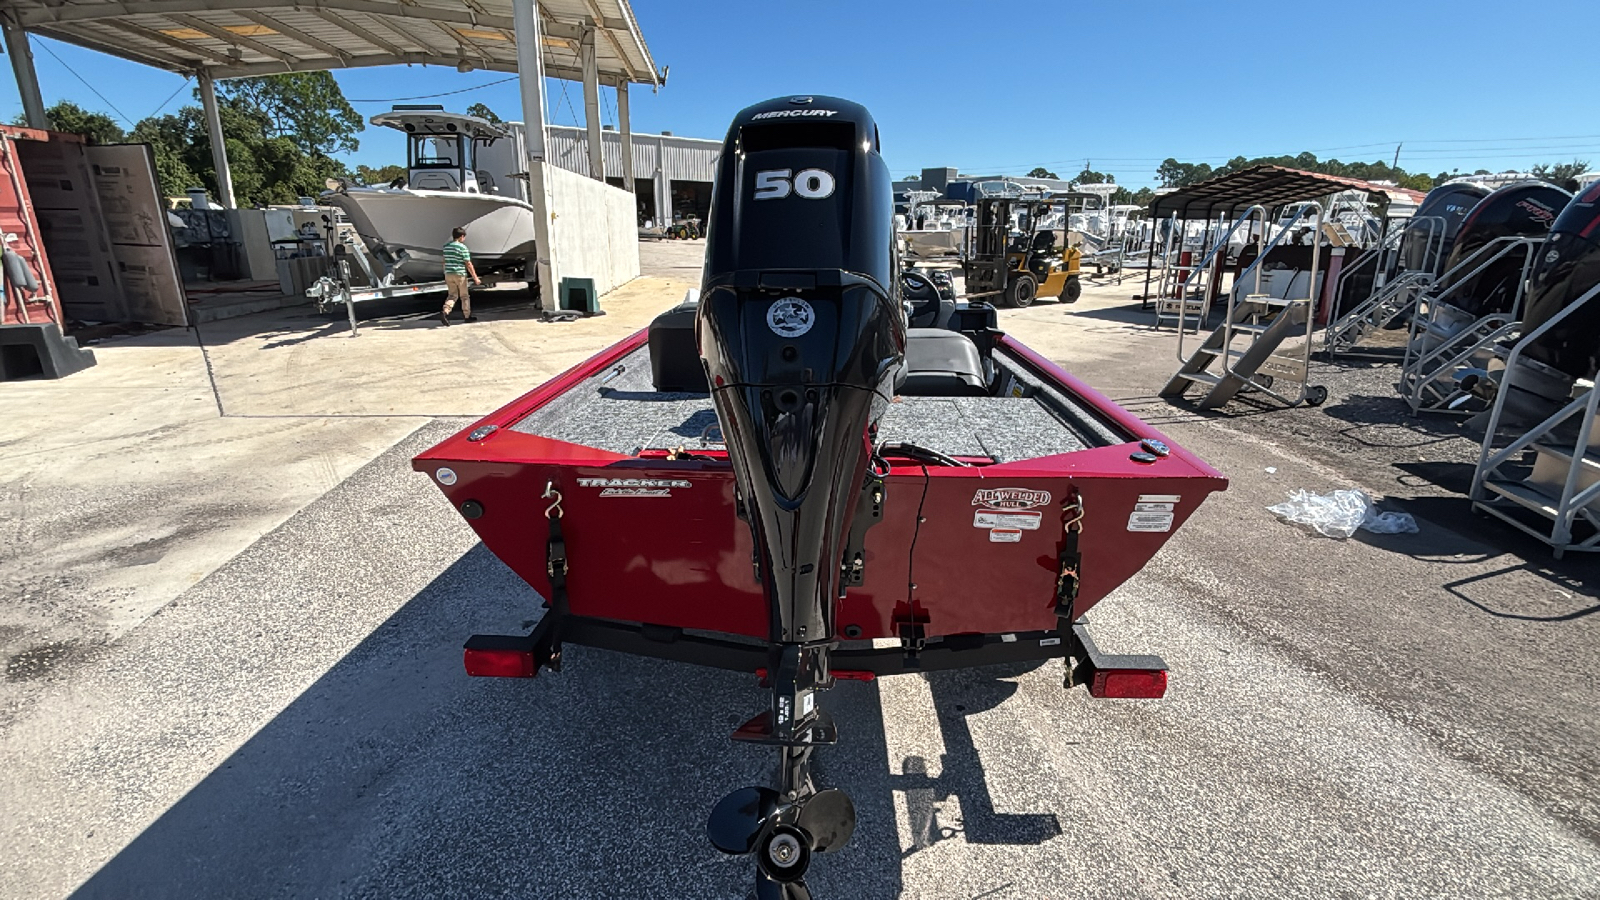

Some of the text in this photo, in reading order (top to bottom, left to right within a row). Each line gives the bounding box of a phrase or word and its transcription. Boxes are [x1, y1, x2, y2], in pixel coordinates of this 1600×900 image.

[751, 109, 838, 120] MERCURY
[754, 167, 836, 200] 50
[577, 478, 689, 487] TRACKER
[973, 489, 1049, 504] ALL WELDED
